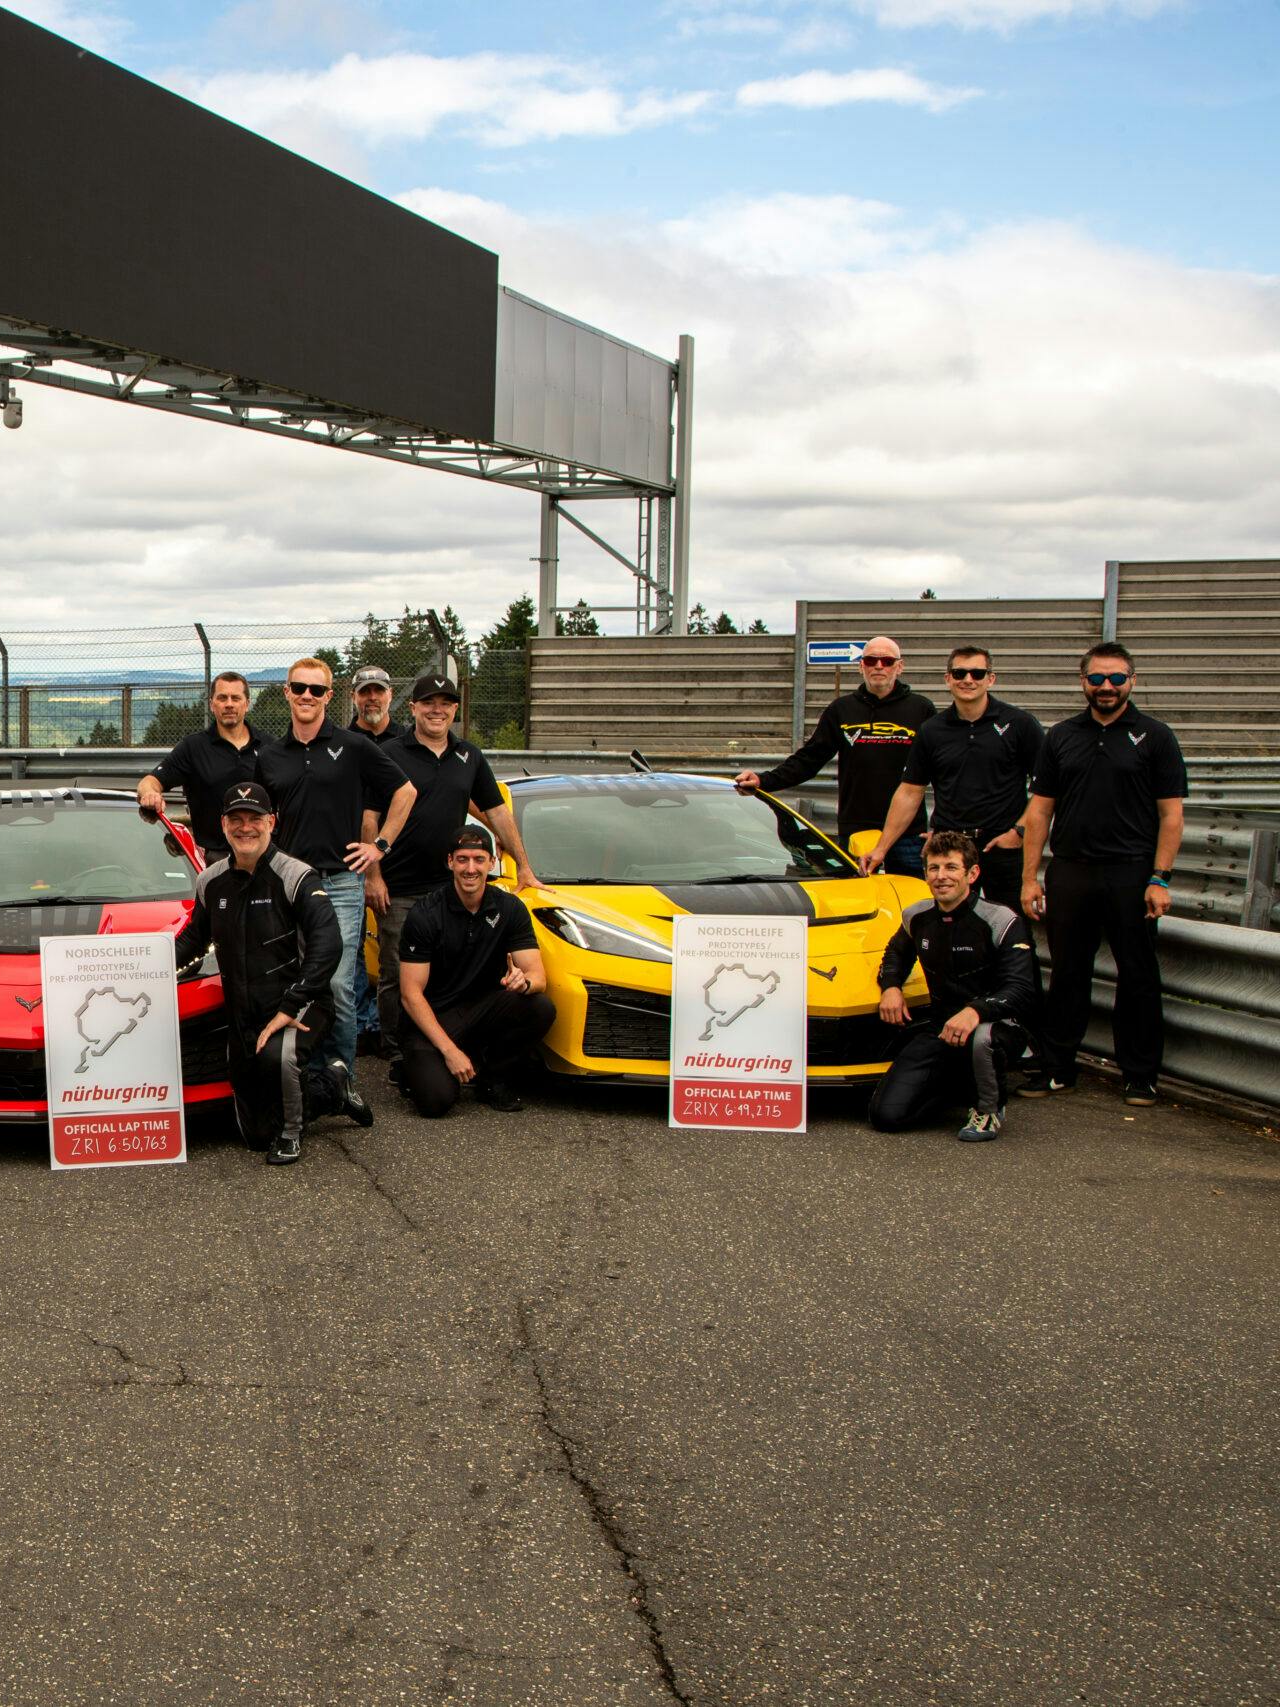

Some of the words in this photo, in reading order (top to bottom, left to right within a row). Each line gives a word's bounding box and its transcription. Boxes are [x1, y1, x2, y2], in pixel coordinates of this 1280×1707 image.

[697, 926, 784, 937] NORDSCHLEIFE
[708, 941, 766, 950] PROTOTYPES
[65, 946, 152, 959] NORDSCHLEIFE
[680, 949, 757, 958] PRE-PRODUCTION
[759, 951, 801, 960] VEHICLES
[77, 962, 135, 972] PROTOTYPES
[49, 972, 127, 983] PRE-PRODUCTION
[128, 970, 169, 980] VEHICLES
[683, 1052, 793, 1073] nürburgring
[61, 1082, 169, 1103] nürburgring
[684, 1087, 736, 1099] OFFICIAL
[739, 1089, 761, 1100] LAP
[763, 1090, 792, 1101] TIME
[64, 1123, 116, 1135] OFFICIAL
[118, 1121, 140, 1132] LAP
[142, 1120, 170, 1131] TIME
